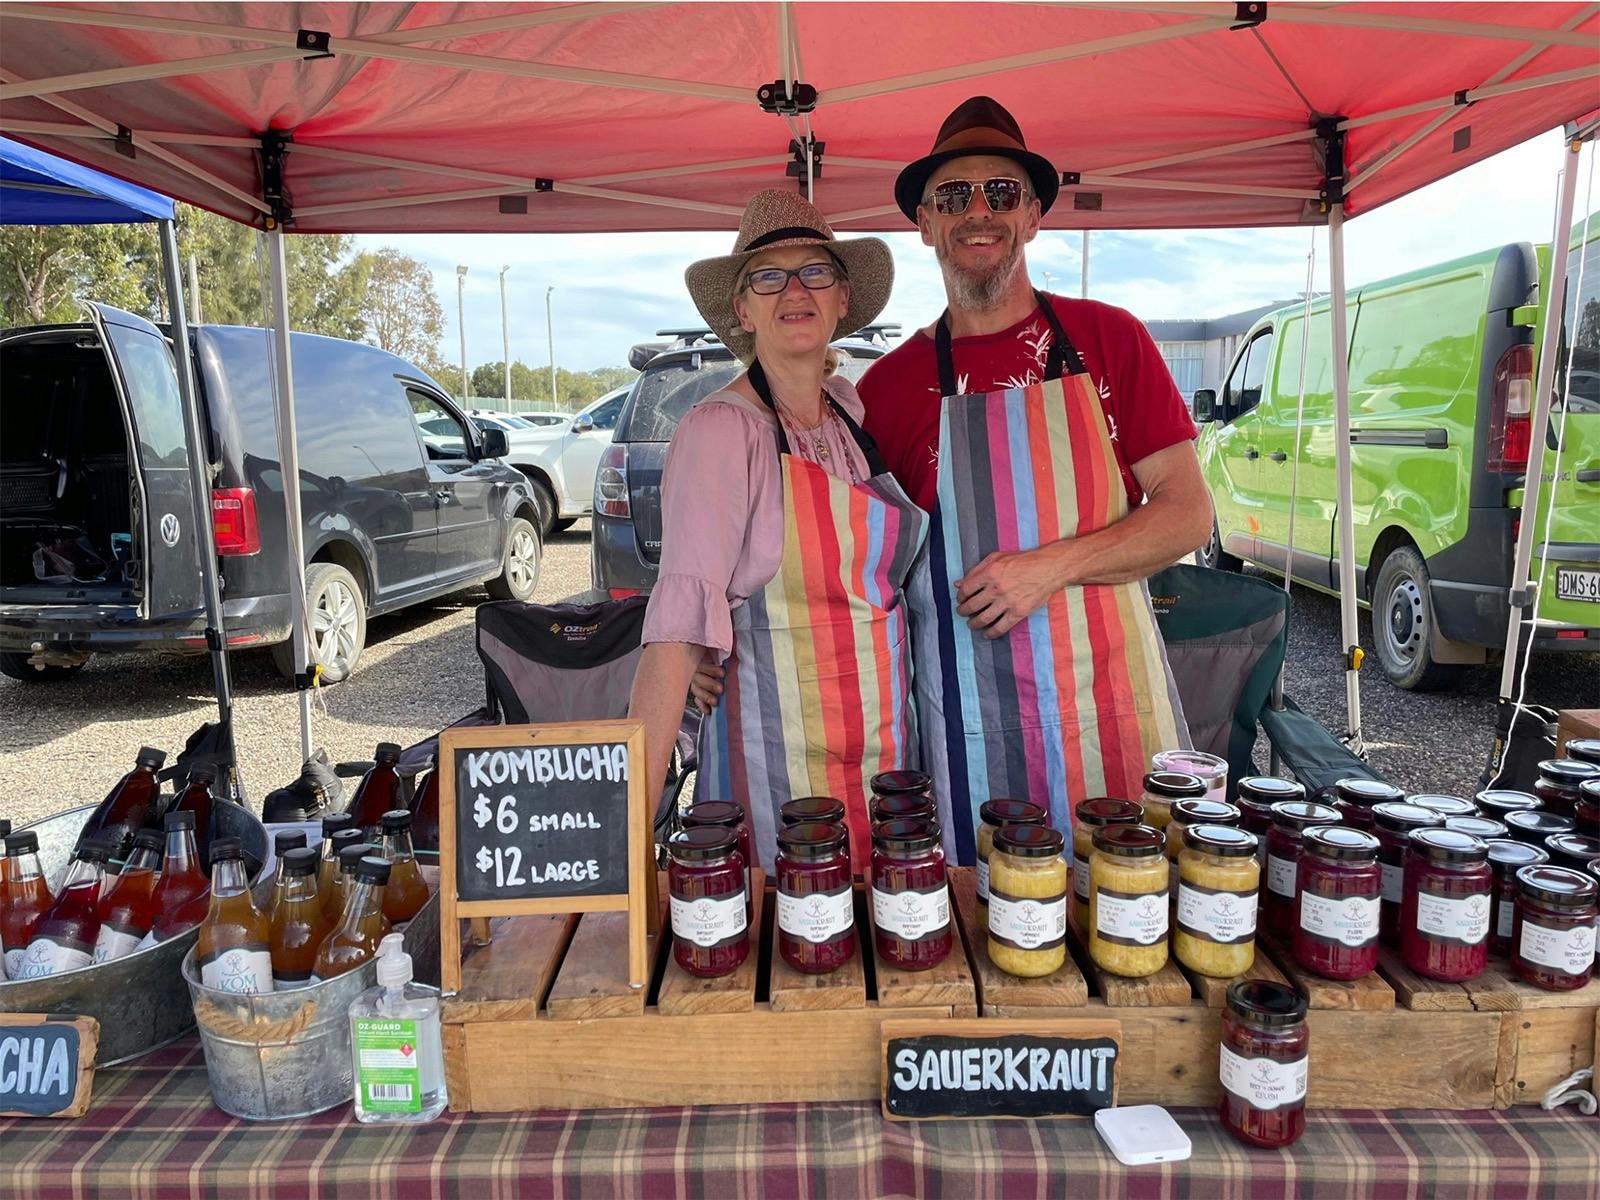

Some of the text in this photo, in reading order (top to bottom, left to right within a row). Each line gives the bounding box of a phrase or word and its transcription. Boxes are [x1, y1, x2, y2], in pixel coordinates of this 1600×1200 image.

[467, 744, 629, 788] KOMBUCHA
[473, 793, 601, 834] $6 SMALL
[475, 846, 600, 887] $12 LARGE
[0, 1036, 69, 1095] CHA
[893, 1046, 1116, 1092] SAUERKRAUT
